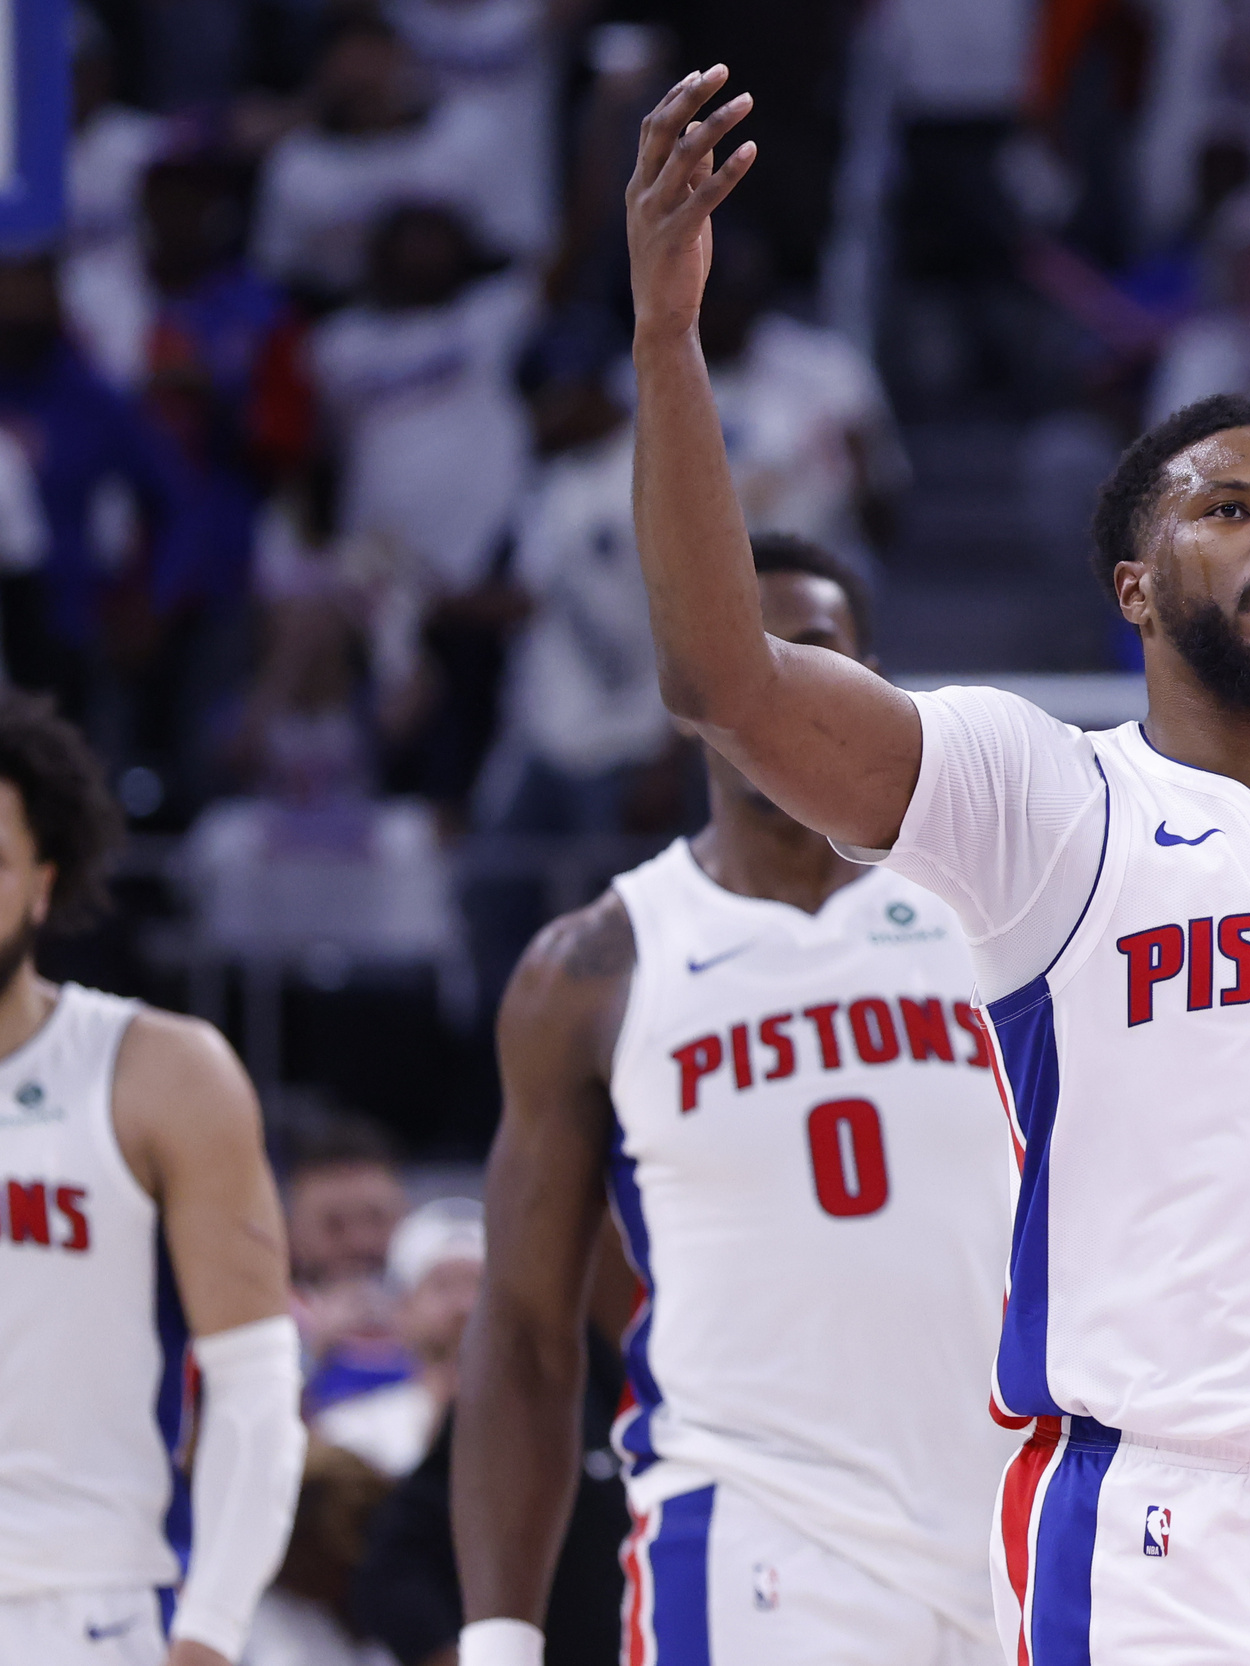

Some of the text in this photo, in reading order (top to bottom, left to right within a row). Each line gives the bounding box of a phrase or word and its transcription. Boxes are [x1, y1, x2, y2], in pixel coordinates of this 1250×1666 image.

[670, 994, 990, 1115] PISTONS
[806, 1096, 892, 1221] 0
[0, 1177, 91, 1254] NS
[1146, 1545, 1160, 1556] NBA
